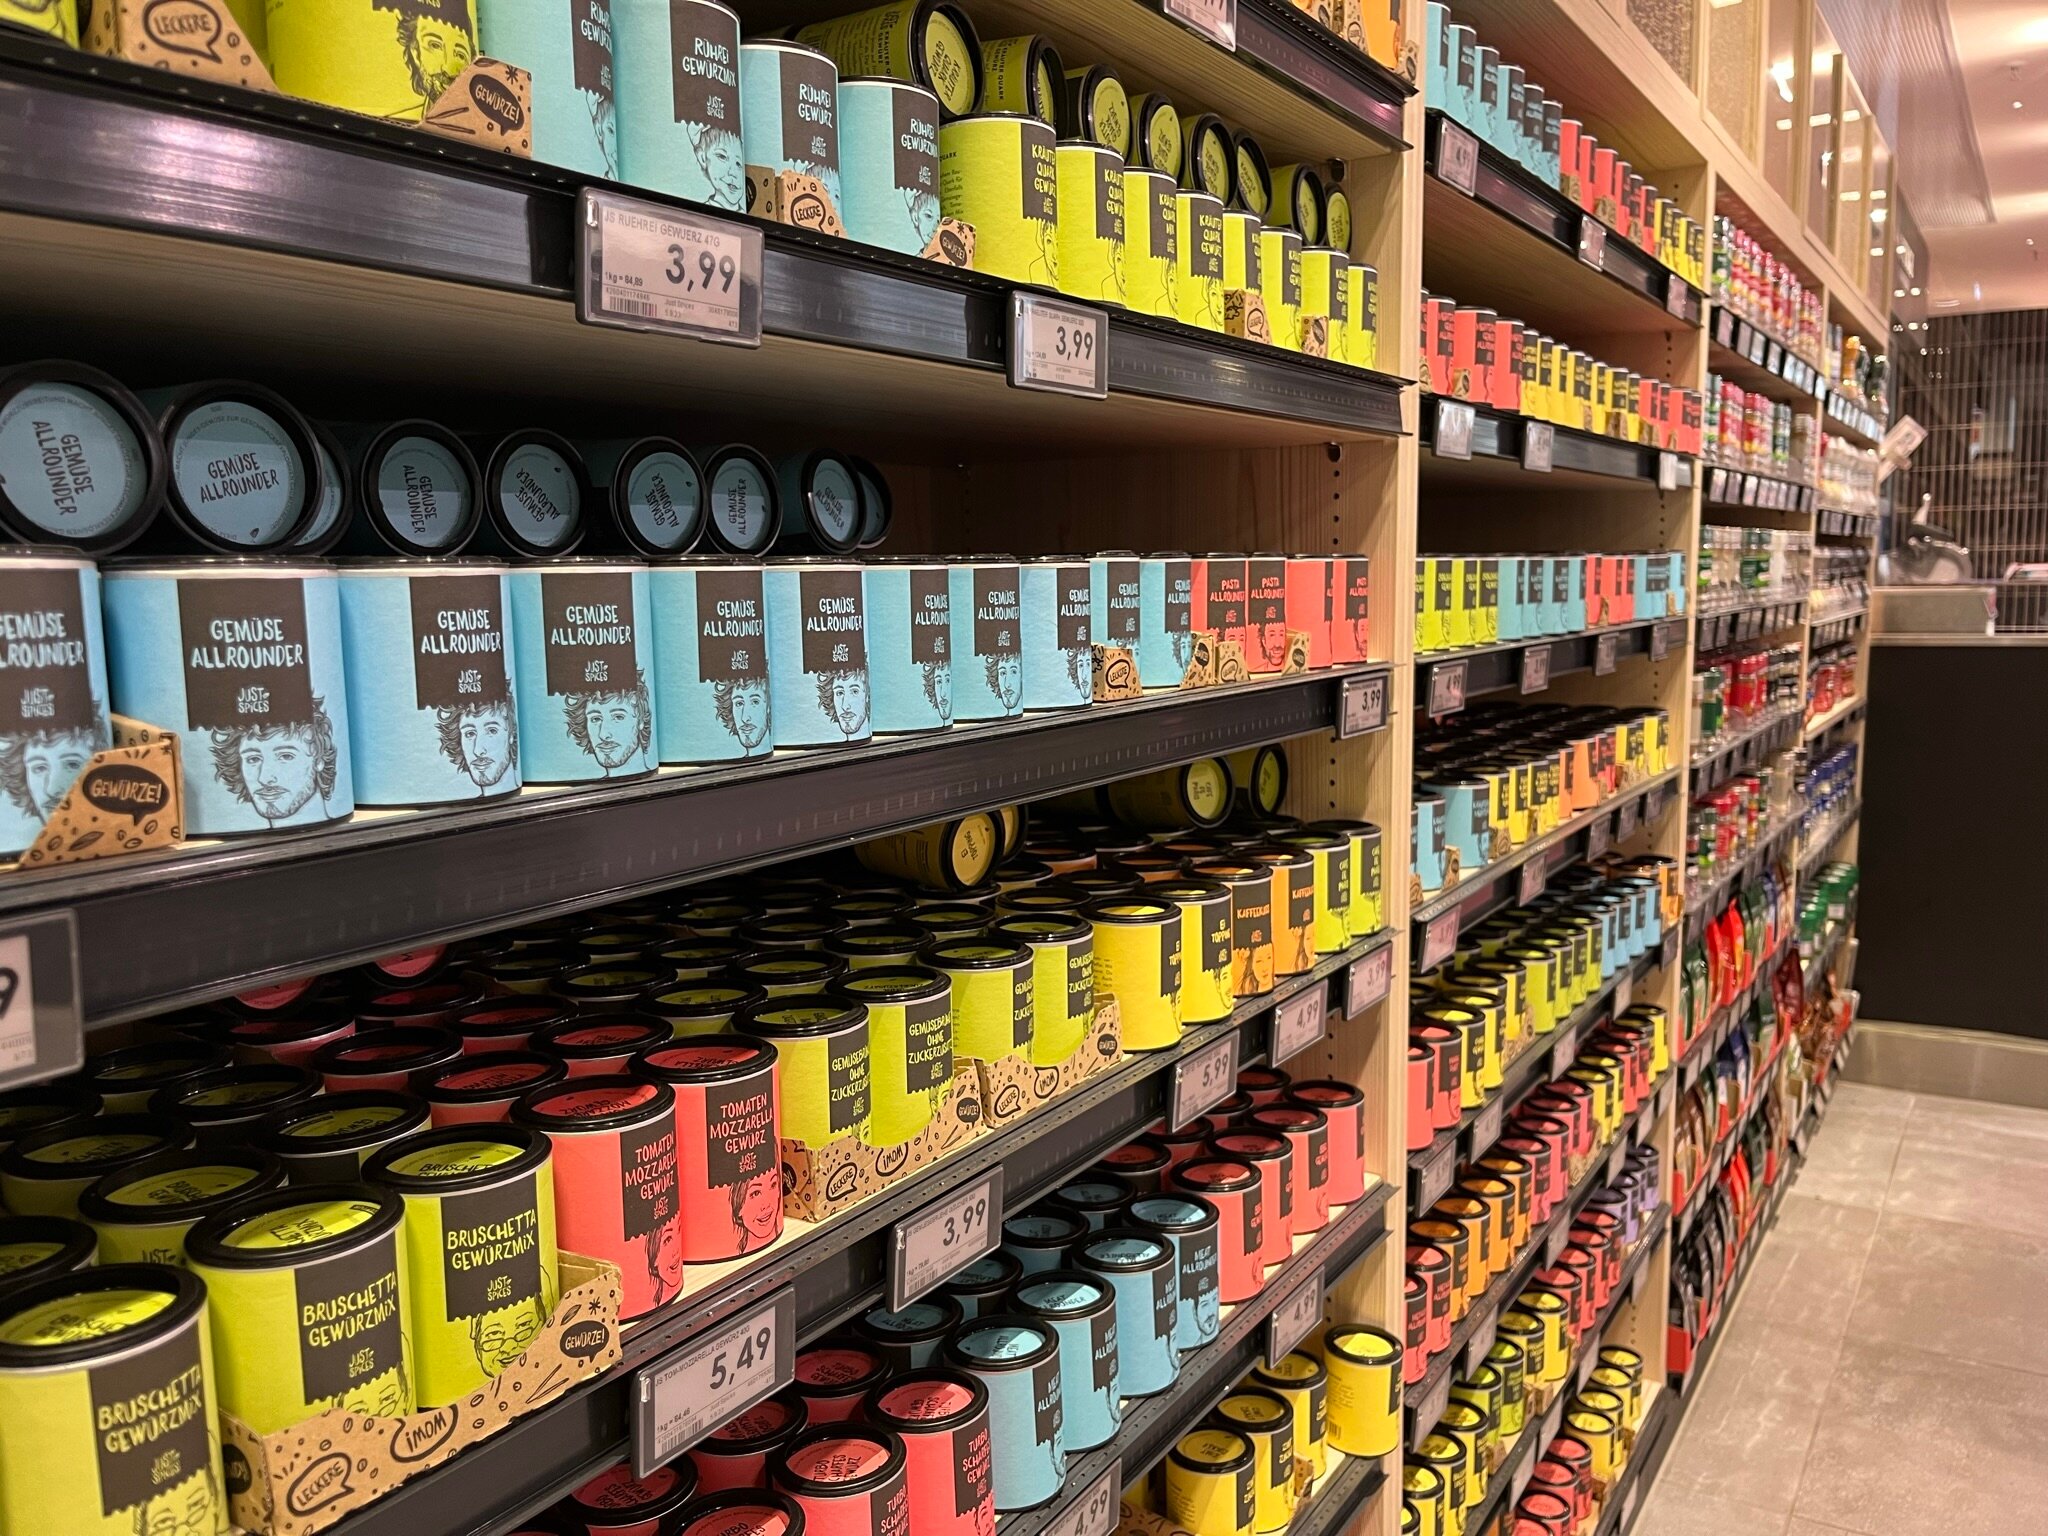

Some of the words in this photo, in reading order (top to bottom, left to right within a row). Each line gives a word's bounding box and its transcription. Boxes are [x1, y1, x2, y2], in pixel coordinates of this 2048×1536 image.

[154, 10, 211, 36] LECKERE
[694, 37, 729, 64] RÜHREI
[475, 84, 521, 124] GEWÜRZE!
[706, 96, 721, 109] JUST
[799, 83, 831, 107] RÜHREI
[798, 103, 832, 129] GEWÜRZ
[794, 205, 821, 223] LECKERE
[605, 211, 615, 223] JS
[619, 214, 657, 233] RUEHREI
[660, 224, 702, 244] GEWUERZ
[704, 233, 720, 247] 47G
[665, 243, 736, 294] 3,99
[1056, 326, 1093, 360] 3,99
[32, 420, 77, 516] ALLROUNDER
[61, 434, 94, 495] GEMÜSE
[207, 452, 260, 479] GEMÜSE
[200, 468, 279, 503] ALLROUNDER
[419, 475, 437, 519] GEMÜSE
[516, 467, 560, 520] ALLROUNDER
[403, 464, 426, 534] ALLROUNDER
[515, 486, 544, 522] GEMÜSE
[737, 478, 747, 535] ALLROUNDER
[1221, 578, 1240, 590] PASTA
[716, 599, 756, 618] GEMÜSE
[819, 597, 855, 614] GEMÜSE
[988, 590, 1016, 605] GEMÜSE
[437, 608, 491, 632] GEMÜSE
[566, 604, 619, 625] GEMÜSE
[807, 615, 862, 632] ALLROUNDER
[210, 617, 284, 643] GEMÜSE
[551, 625, 631, 645] ALLROUNDER
[703, 619, 763, 637] ALLROUNDER
[421, 631, 501, 655] ALLROUNDER
[833, 643, 846, 654] JUST
[191, 644, 304, 669] ALLROUNDER
[585, 660, 604, 673] JUST
[731, 650, 746, 661] JUST
[731, 660, 749, 670] SPICES
[458, 669, 477, 683] JUST
[458, 681, 482, 693] SPICES
[585, 671, 608, 682] SPICES
[21, 688, 48, 705] JUST
[238, 687, 264, 702] JUST
[238, 700, 270, 713] SPICES
[1362, 690, 1381, 711] 3,99
[92, 778, 162, 804] GEWÜRZE!
[1367, 960, 1386, 987] 3,99
[1296, 1000, 1319, 1027] 4,99
[927, 1030, 944, 1046] OHNE
[849, 1064, 865, 1081] OHNE
[1202, 1054, 1229, 1087] 5,99
[720, 1092, 767, 1119] TOMATEN
[958, 1104, 979, 1117] GEWÜRZE!
[999, 1089, 1018, 1113] LECKERE
[710, 1108, 774, 1139] MOZZARELLA
[635, 1131, 674, 1163] TOMATEN
[725, 1129, 766, 1153] GEWÜRZ
[739, 1152, 754, 1165] JUST
[739, 1160, 757, 1173] SPICES
[640, 1170, 675, 1200] GEWÜRZ
[829, 1168, 854, 1199] LECKERE
[447, 1209, 537, 1250] BRUSCHETTA
[943, 1198, 986, 1247] 3,99
[452, 1232, 535, 1271] GEWÜRZMIX
[1194, 1246, 1211, 1261] MEAT
[487, 1276, 507, 1293] JUST
[487, 1285, 512, 1301] SPICES
[303, 1270, 397, 1326] BRUSCHETTA
[309, 1294, 396, 1348] GEWÜRZMIX
[565, 1327, 606, 1350] GEWÜRZE!
[349, 1348, 370, 1367] JUST
[349, 1358, 374, 1378] SPICES
[709, 1327, 771, 1390] 5,49
[97, 1364, 201, 1431] BRUSCHETTA
[968, 1428, 988, 1452] TURBO
[152, 1449, 175, 1473] JUST
[297, 1461, 344, 1507] LECKERE
[887, 1484, 907, 1511] TURBO
[1075, 1490, 1107, 1536] 4,99
